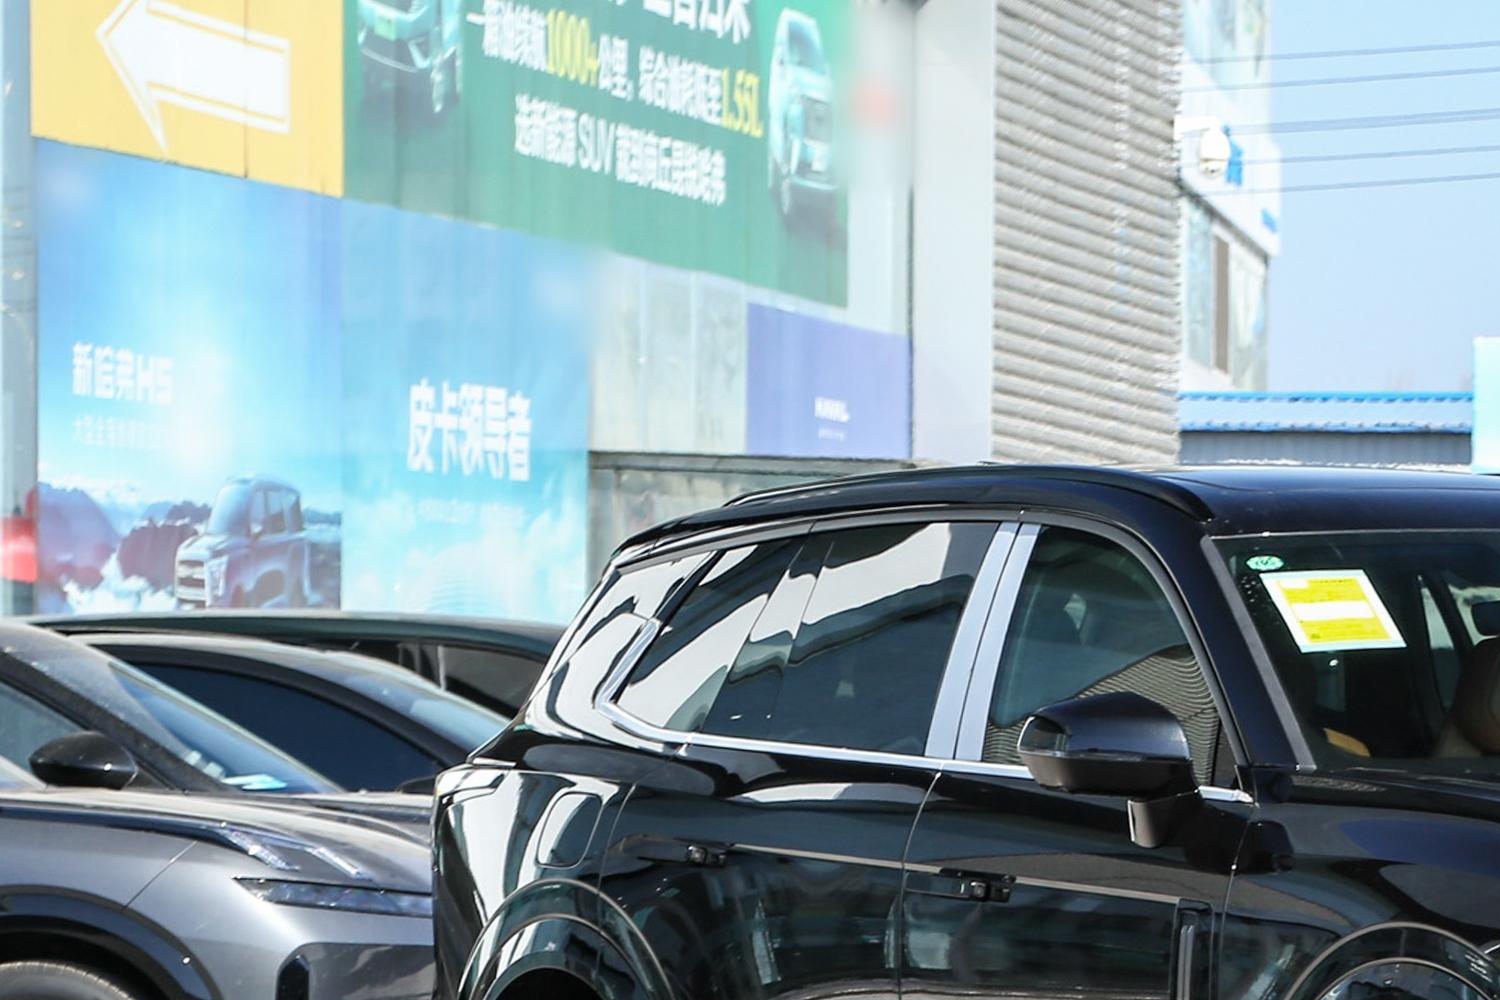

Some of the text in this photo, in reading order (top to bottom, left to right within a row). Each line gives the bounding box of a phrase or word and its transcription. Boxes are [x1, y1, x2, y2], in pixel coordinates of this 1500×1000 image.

[407, 378, 532, 481] 皮卡领导者
